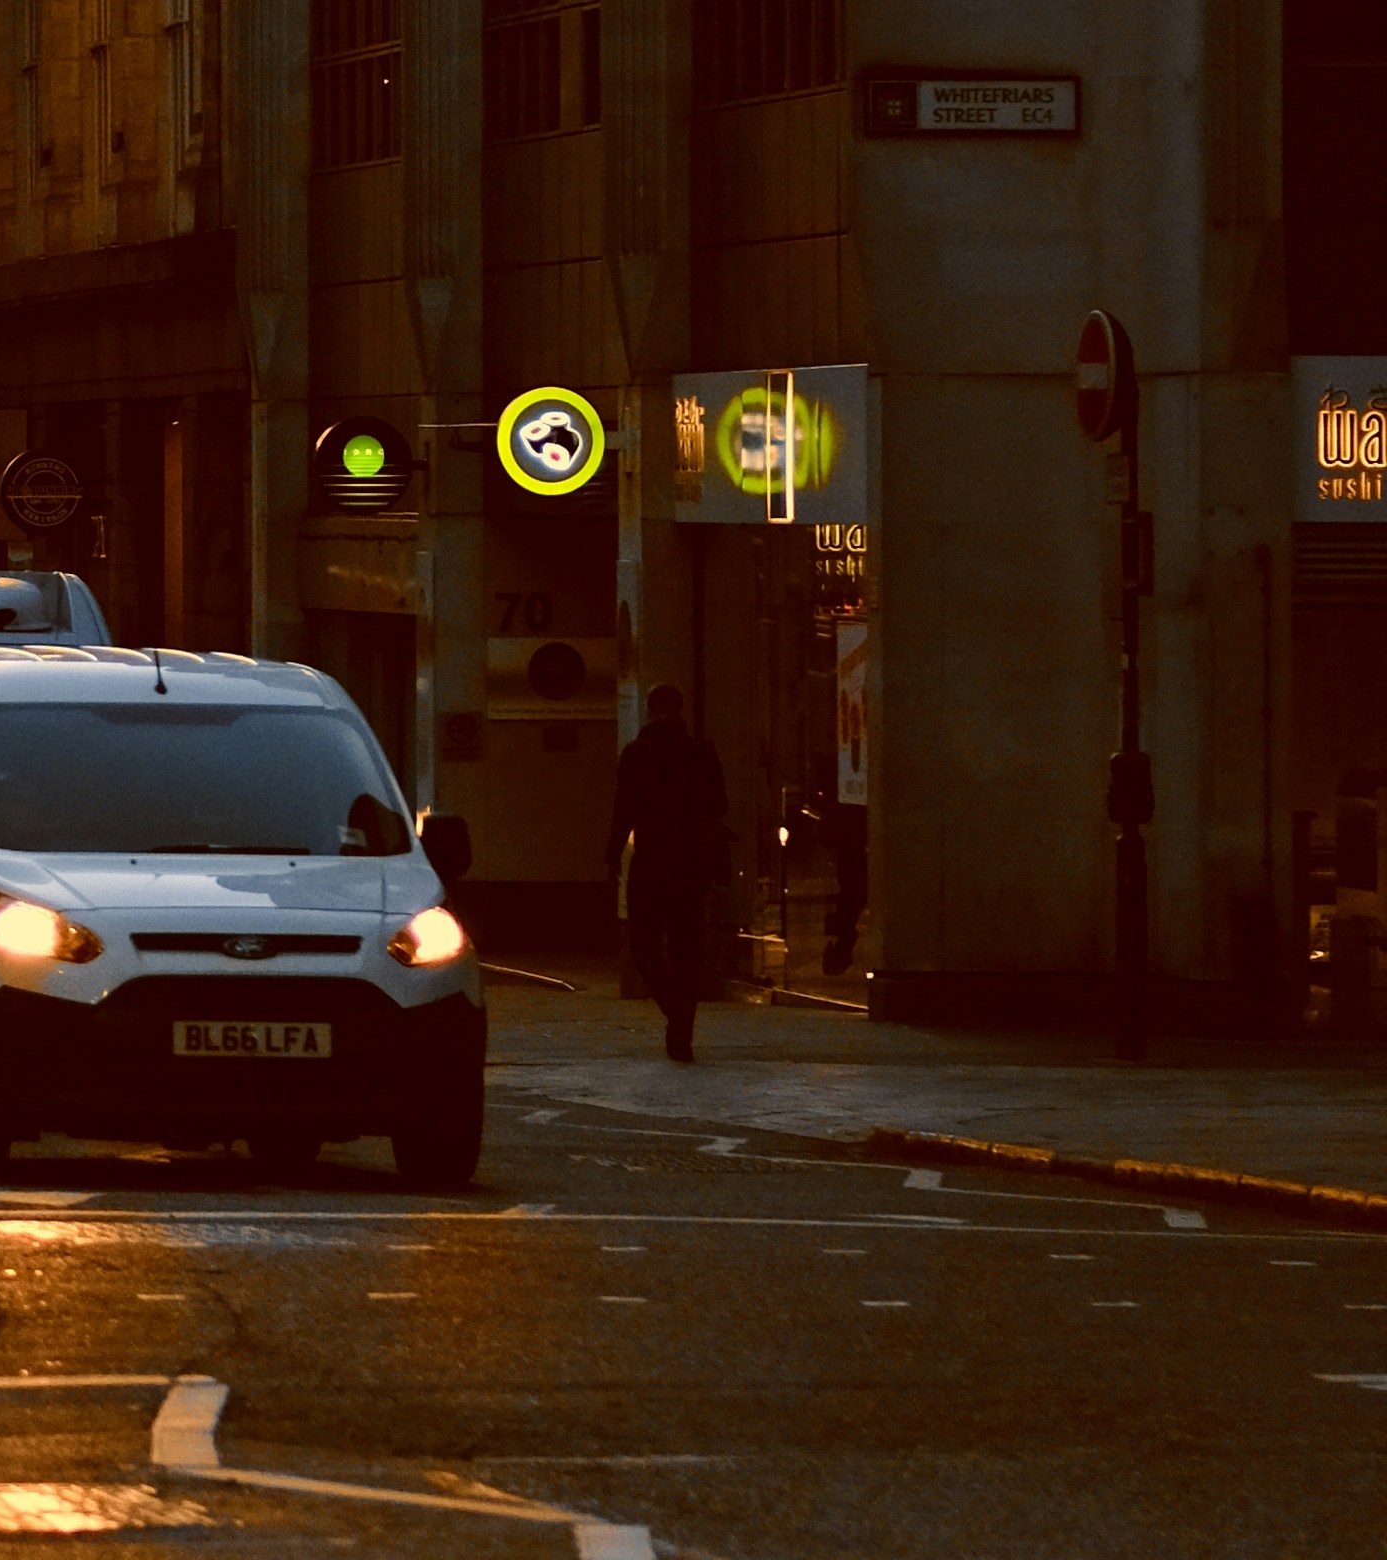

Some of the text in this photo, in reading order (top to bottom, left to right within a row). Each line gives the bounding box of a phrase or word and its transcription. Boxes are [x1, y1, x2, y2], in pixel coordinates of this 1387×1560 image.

[933, 88, 1054, 103] WHITEFRIARS
[933, 108, 1054, 123] STREET EC4
[1318, 470, 1383, 500] sushi
[495, 591, 553, 633] 70
[184, 1025, 319, 1053] BL66 LFA
